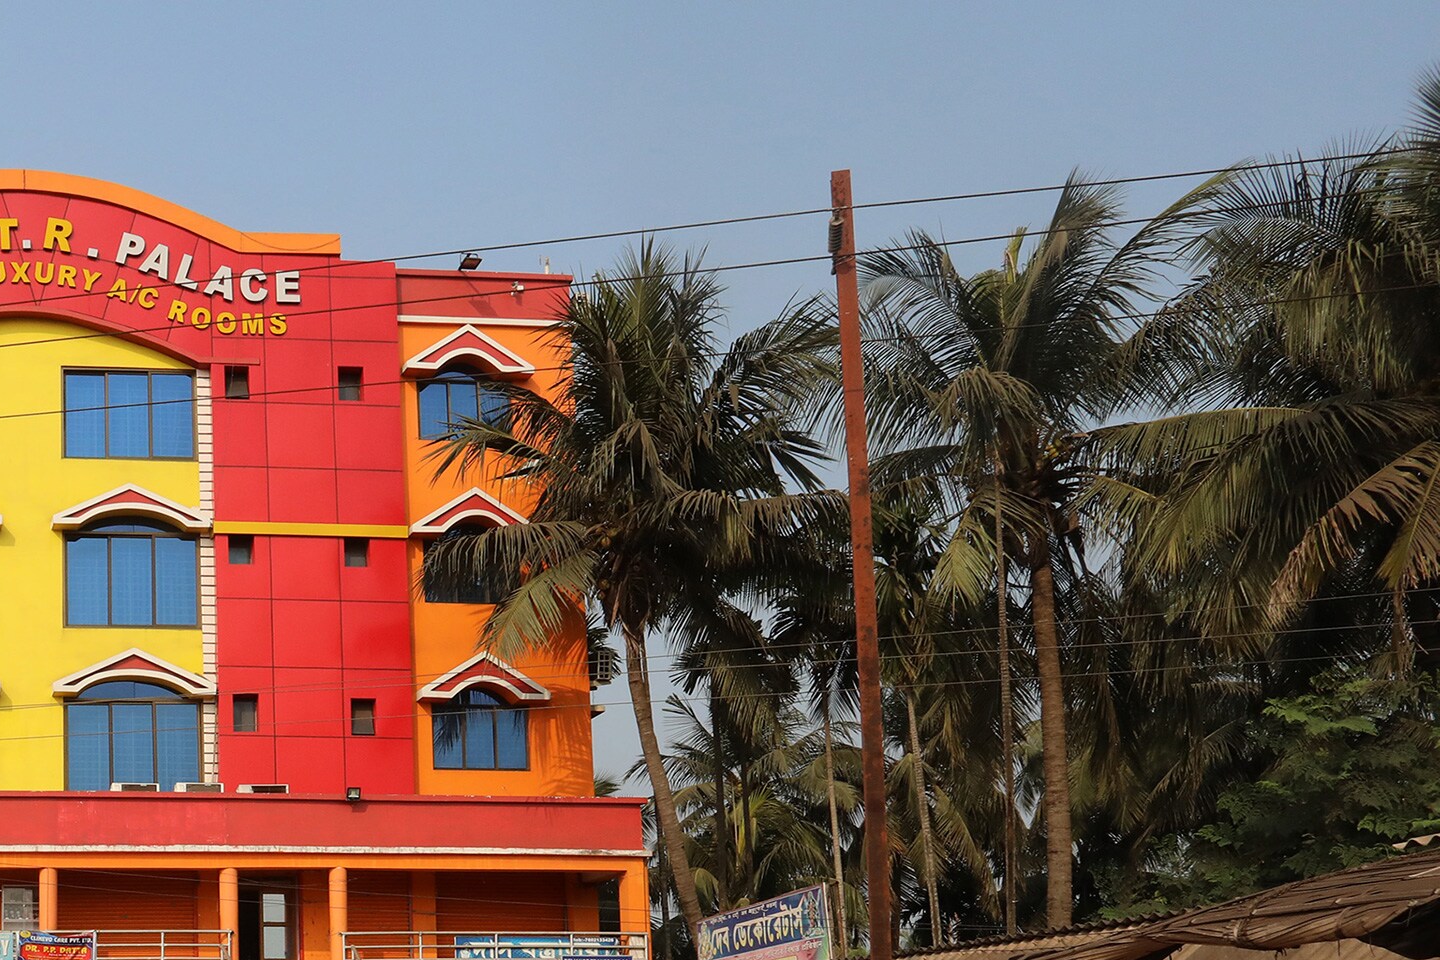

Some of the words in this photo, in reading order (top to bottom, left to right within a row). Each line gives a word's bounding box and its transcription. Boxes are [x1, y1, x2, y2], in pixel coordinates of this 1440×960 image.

[115, 231, 302, 303] PALACE
[106, 279, 158, 309] A/C
[167, 299, 289, 335] ROOMS
